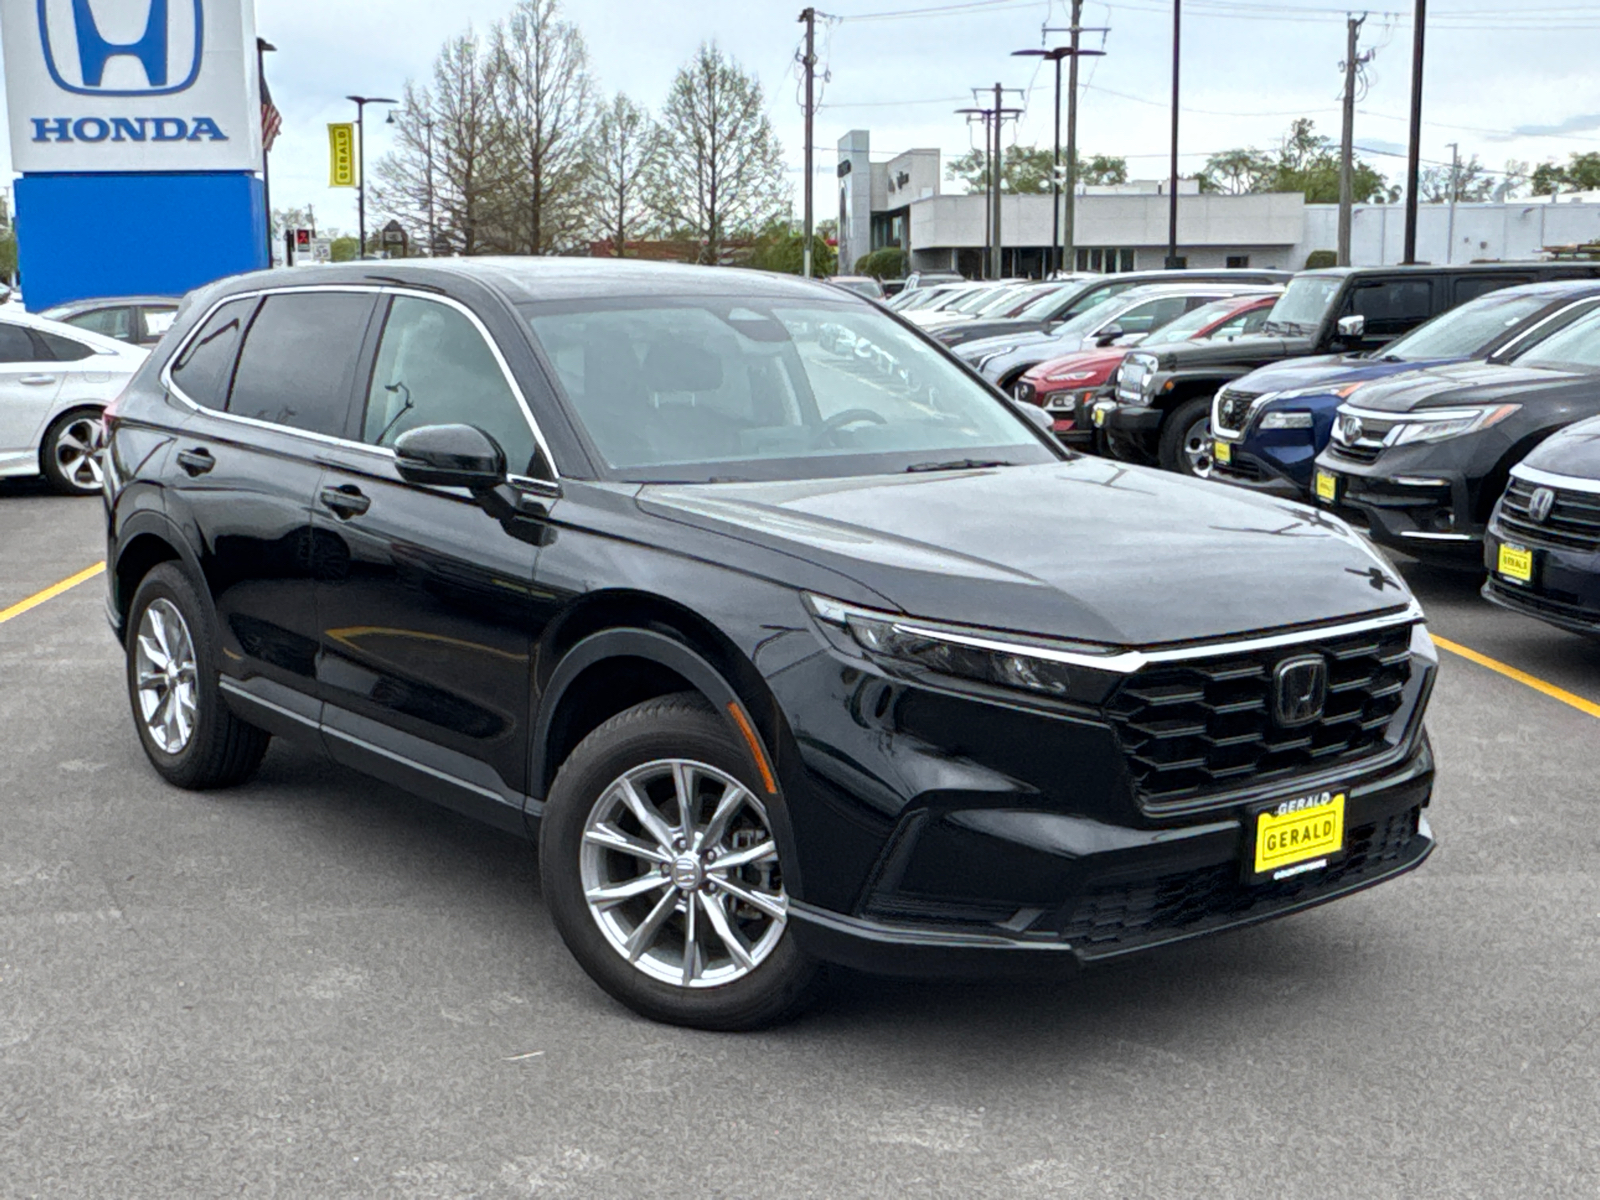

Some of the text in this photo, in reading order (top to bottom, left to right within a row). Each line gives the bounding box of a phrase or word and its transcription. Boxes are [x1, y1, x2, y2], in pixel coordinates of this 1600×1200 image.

[30, 117, 229, 142] HONDA
[338, 131, 348, 179] GERALD
[1277, 791, 1331, 816] GERALD
[1267, 820, 1332, 851] GERALD
